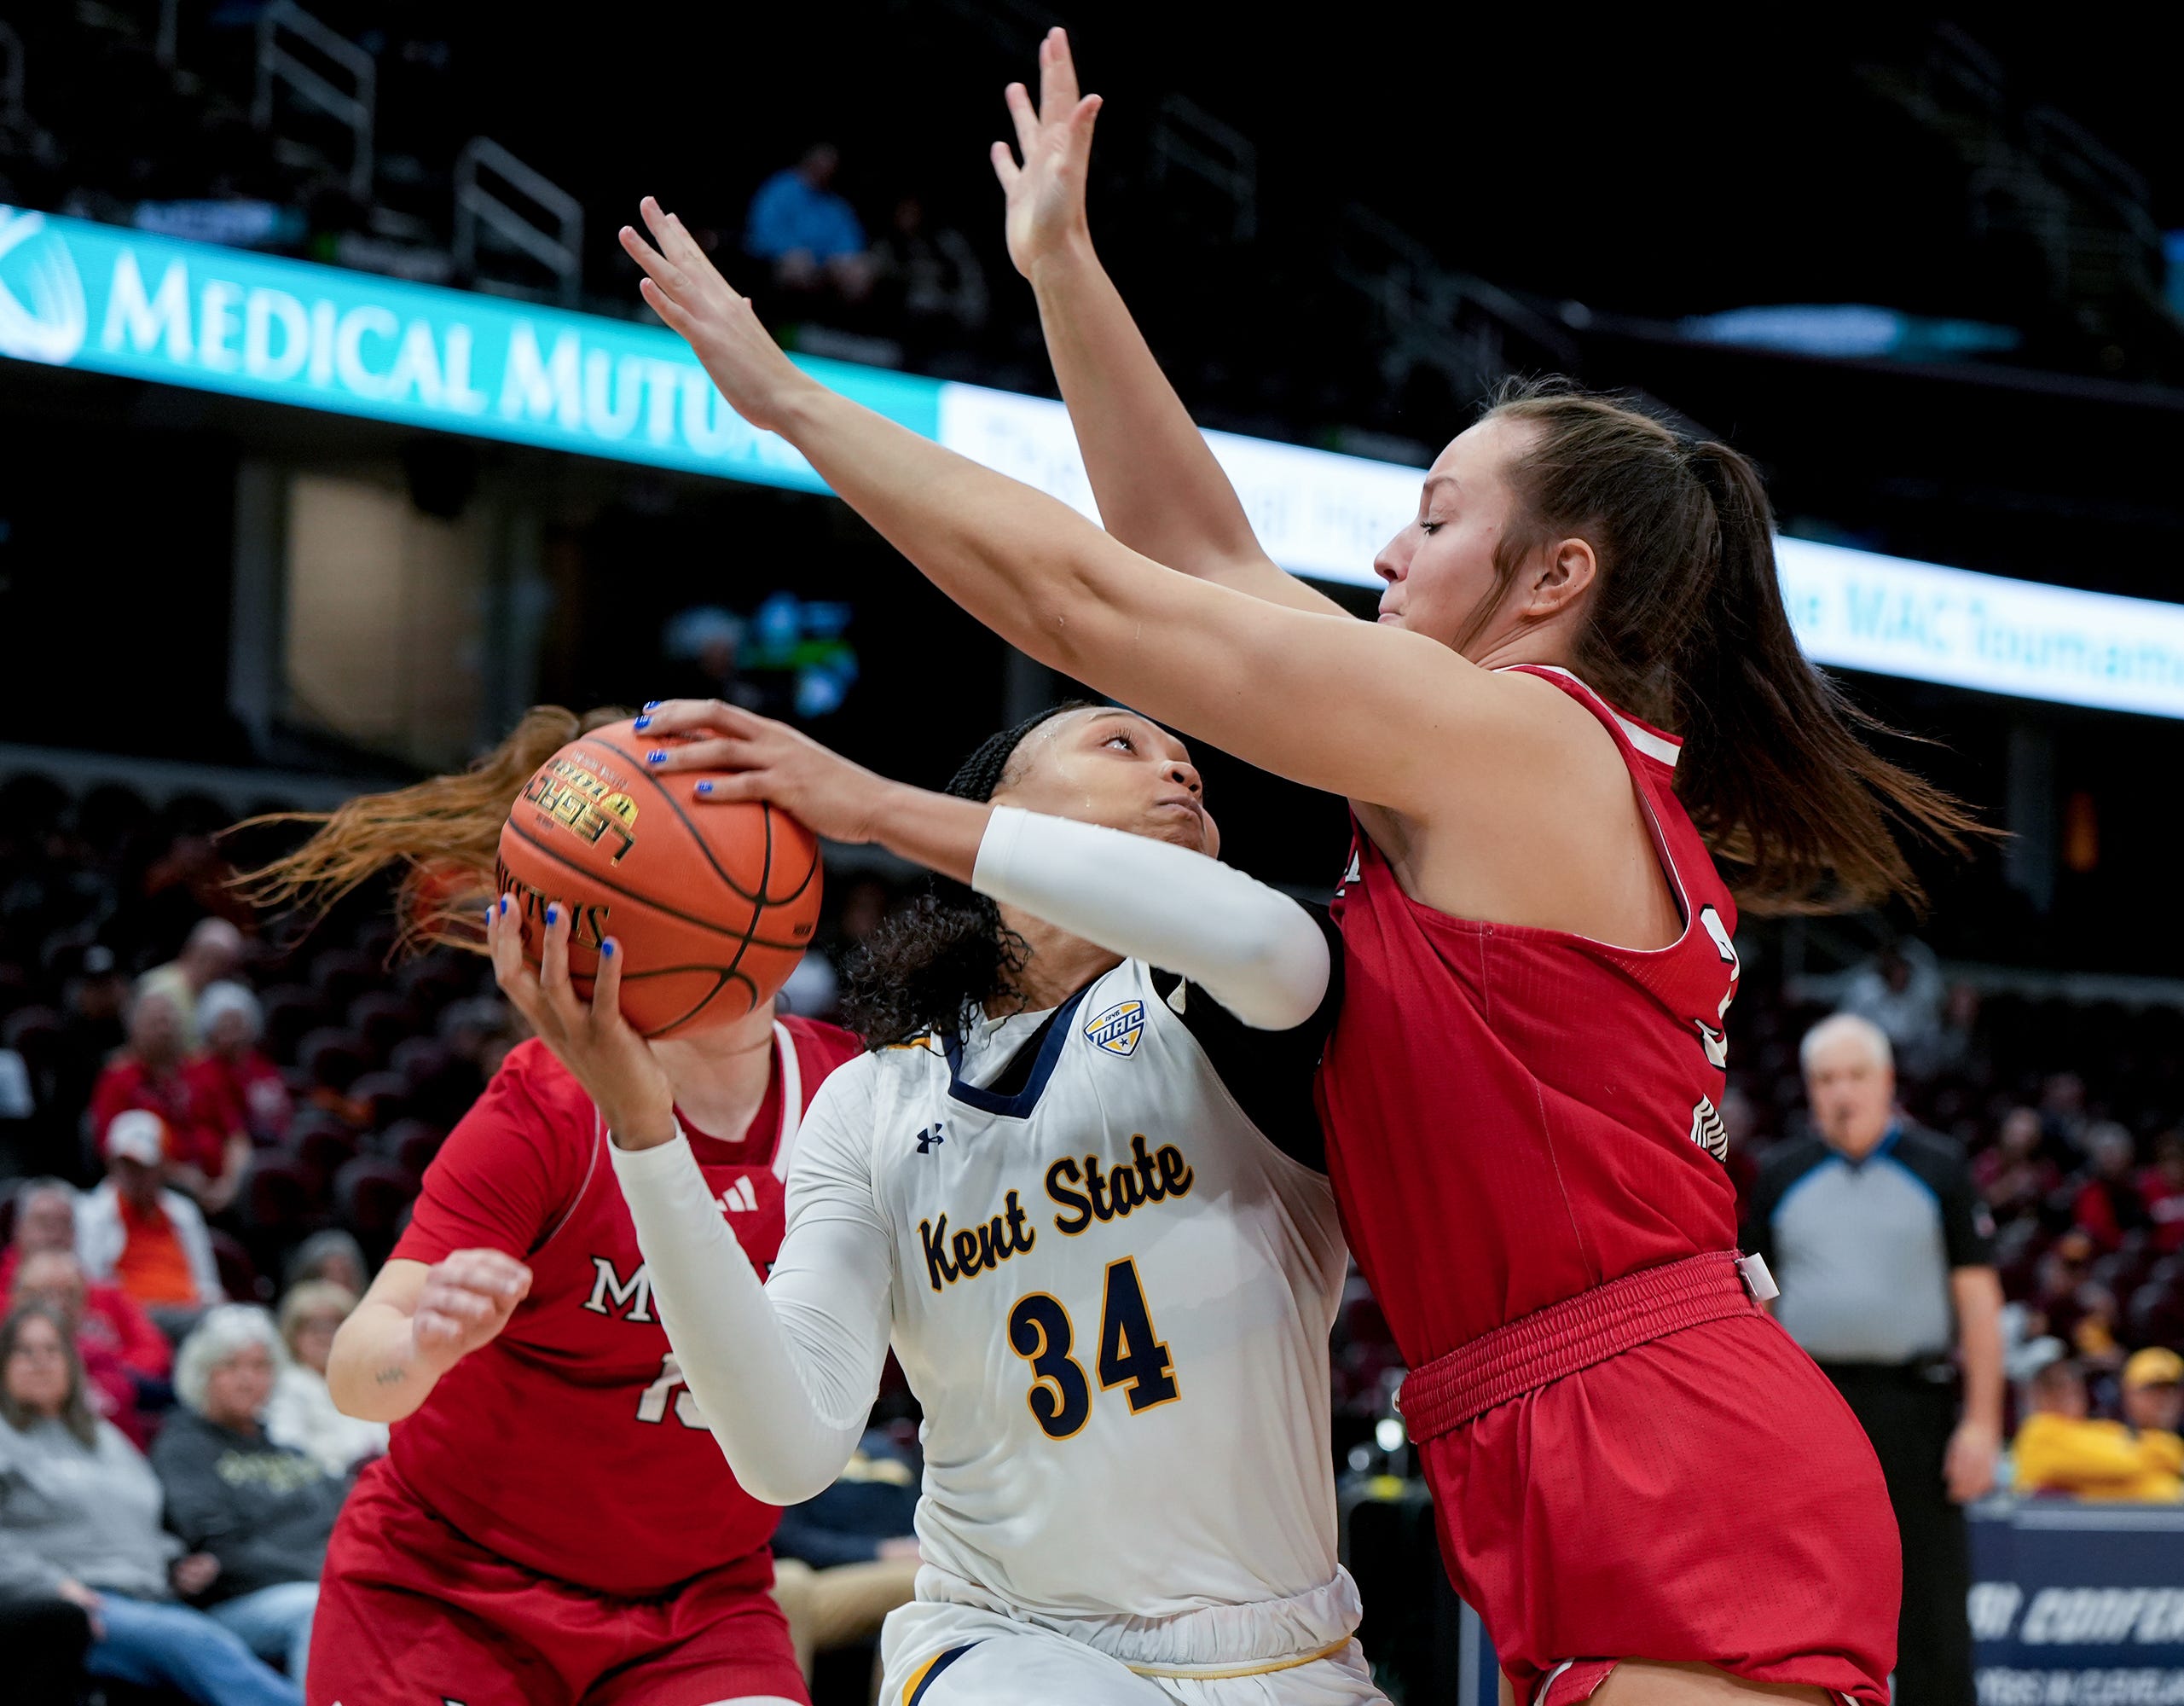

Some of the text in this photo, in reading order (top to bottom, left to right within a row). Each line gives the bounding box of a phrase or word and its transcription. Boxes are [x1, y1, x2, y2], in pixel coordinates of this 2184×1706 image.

[100, 246, 490, 415] MEDICAL
[499, 316, 816, 473] MUTU
[1091, 1009, 1144, 1046] MAC
[917, 1134, 1194, 1292] Kent State
[1006, 1255, 1182, 1441] 34
